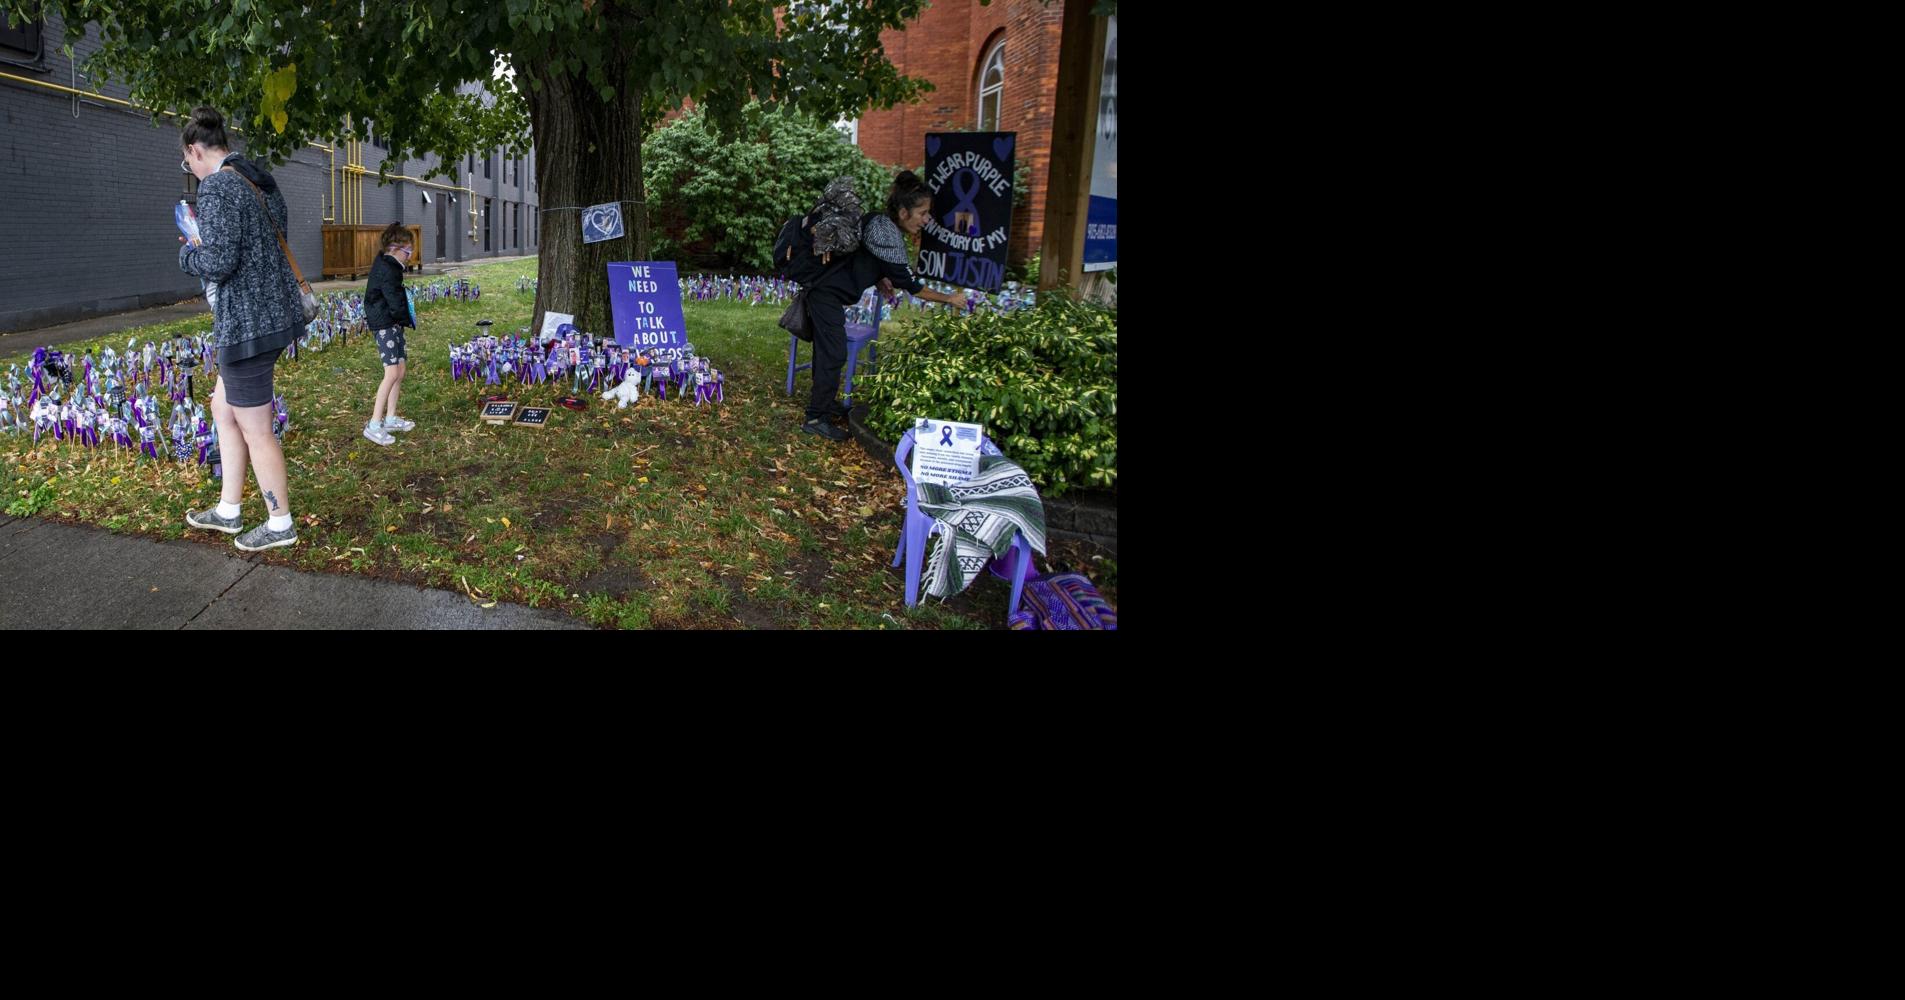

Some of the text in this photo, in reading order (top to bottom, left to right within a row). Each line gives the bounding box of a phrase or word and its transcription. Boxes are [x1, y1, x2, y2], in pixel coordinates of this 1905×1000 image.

[928, 150, 1011, 197] I WEAR PURPLE
[931, 224, 971, 252] MEMORY
[971, 237, 986, 254] OF
[986, 226, 1008, 249] MY
[631, 265, 651, 278] WE
[917, 249, 947, 279] SON
[943, 252, 1005, 294] JUSTIN
[628, 280, 658, 293] NEED
[638, 301, 655, 314] TO
[635, 316, 665, 330] TALK
[633, 331, 677, 346] ABOUT
